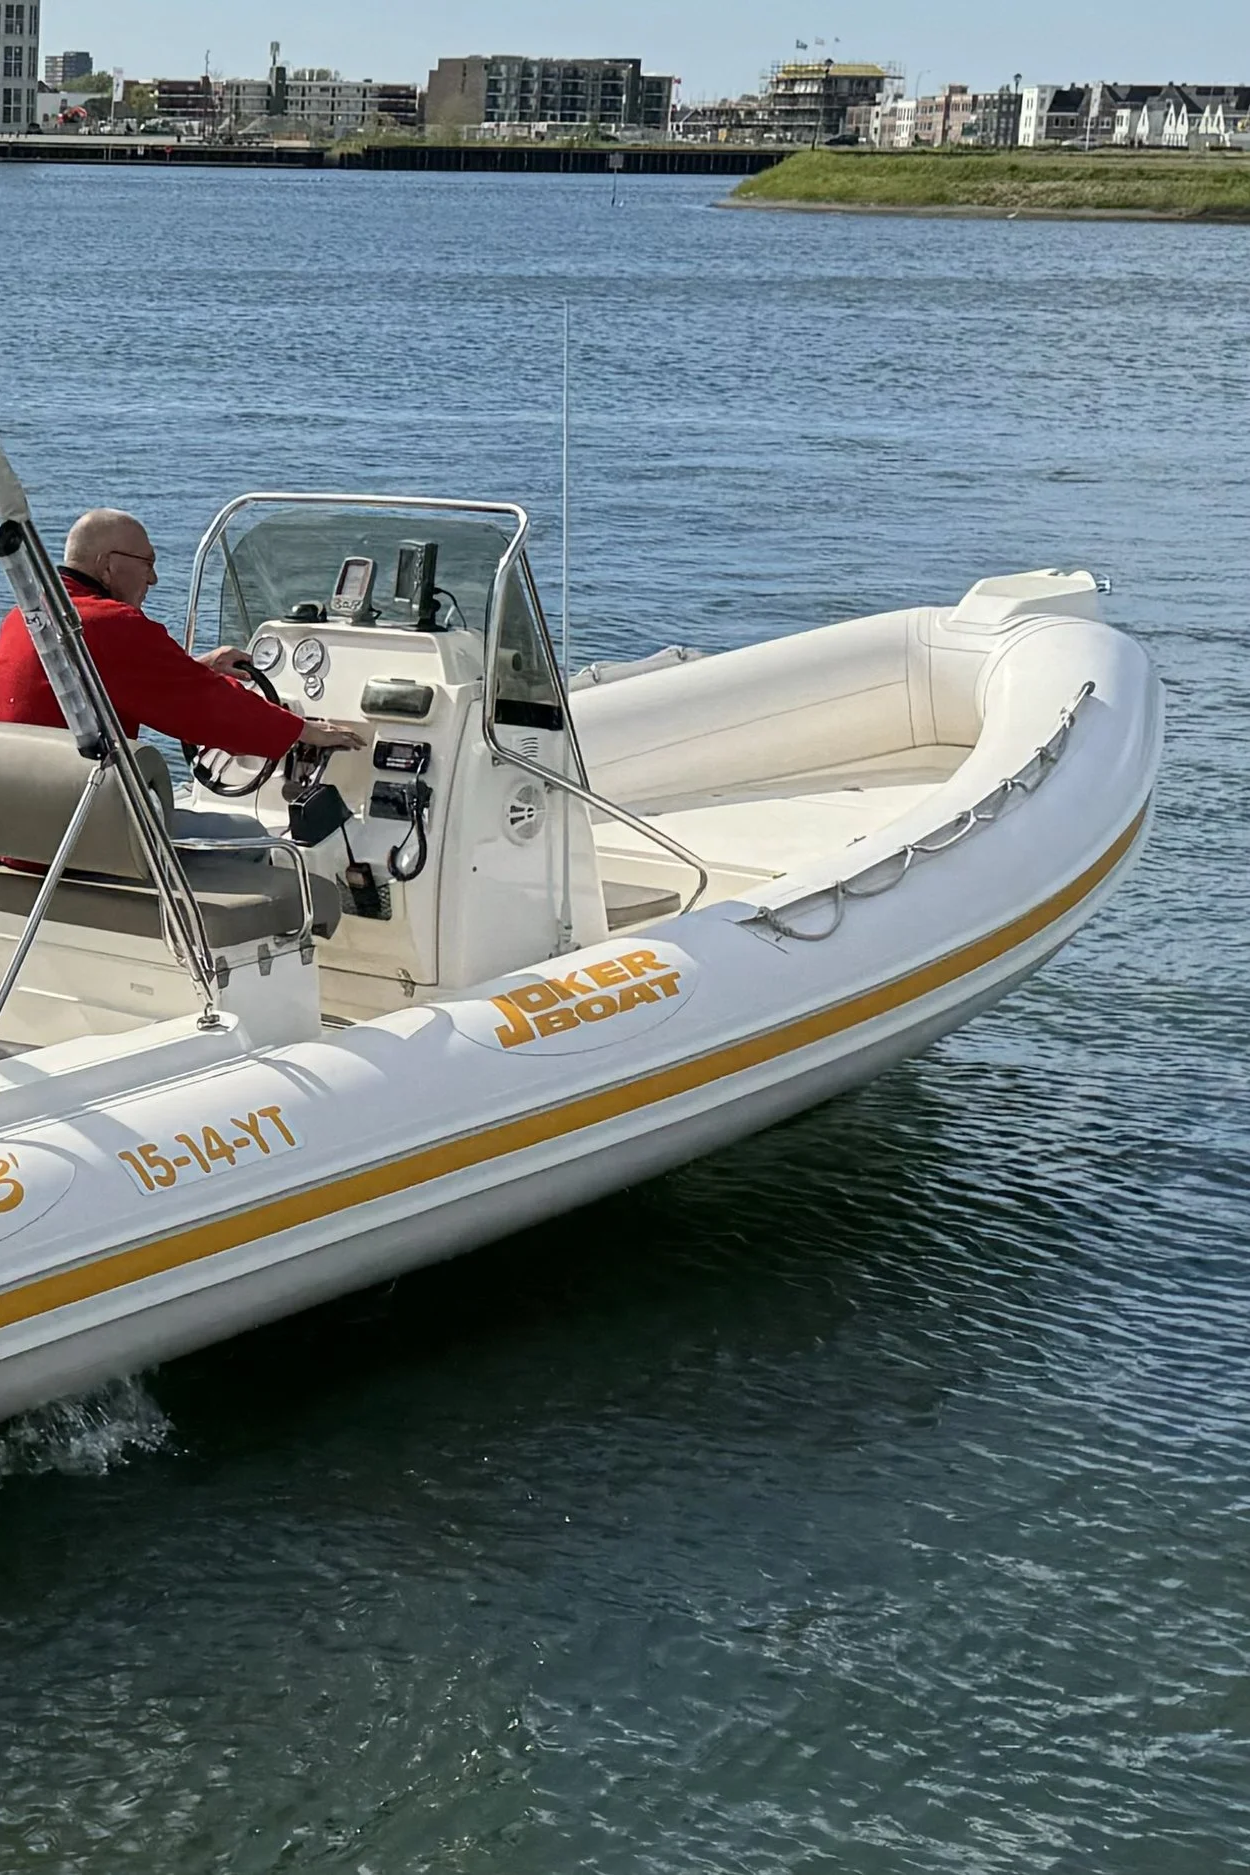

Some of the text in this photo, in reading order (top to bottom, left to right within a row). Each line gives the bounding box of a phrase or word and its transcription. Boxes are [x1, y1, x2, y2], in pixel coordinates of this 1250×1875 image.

[489, 949, 671, 1049] JOKER
[533, 971, 682, 1037] BOAT
[118, 1105, 296, 1190] 15-14-YT
